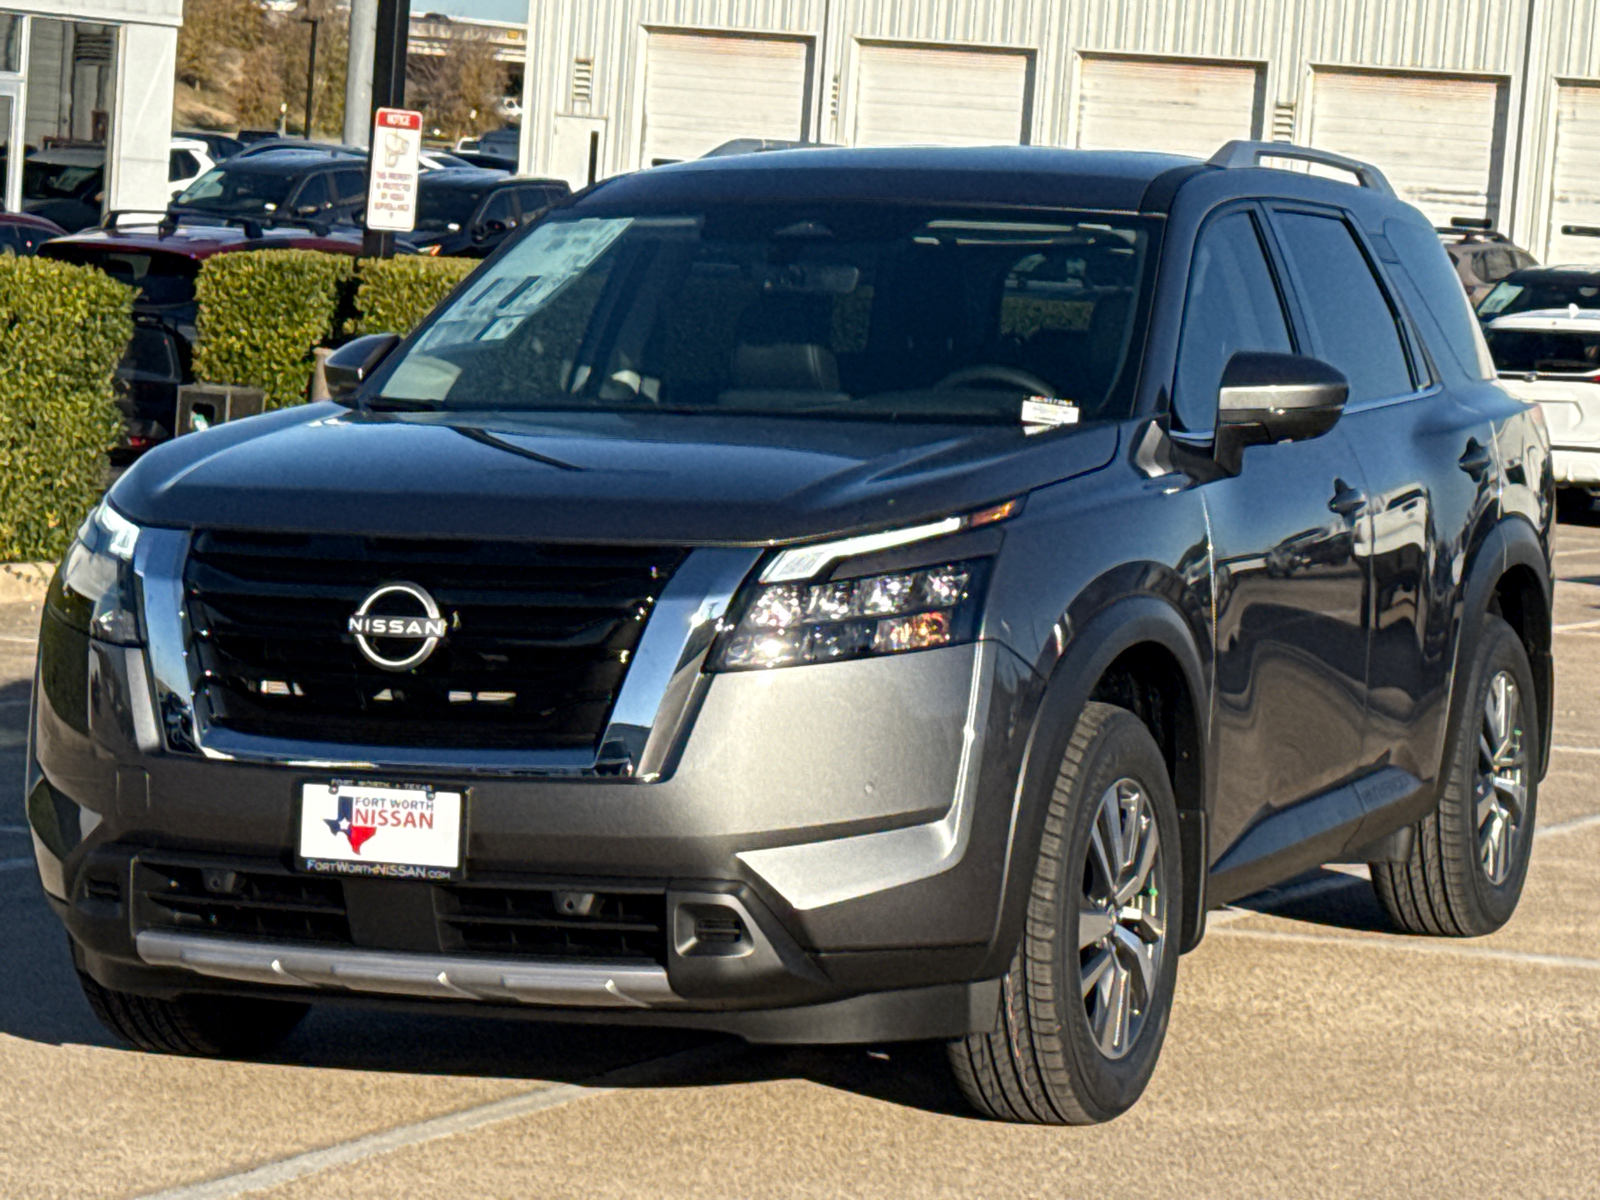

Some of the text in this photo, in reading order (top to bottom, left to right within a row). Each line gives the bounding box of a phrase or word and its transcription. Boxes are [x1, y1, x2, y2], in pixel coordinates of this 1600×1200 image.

[387, 113, 411, 126] NOTICE
[348, 617, 442, 635] NISSAN
[355, 796, 434, 811] FORT WORTH
[355, 808, 434, 829] NISSAN
